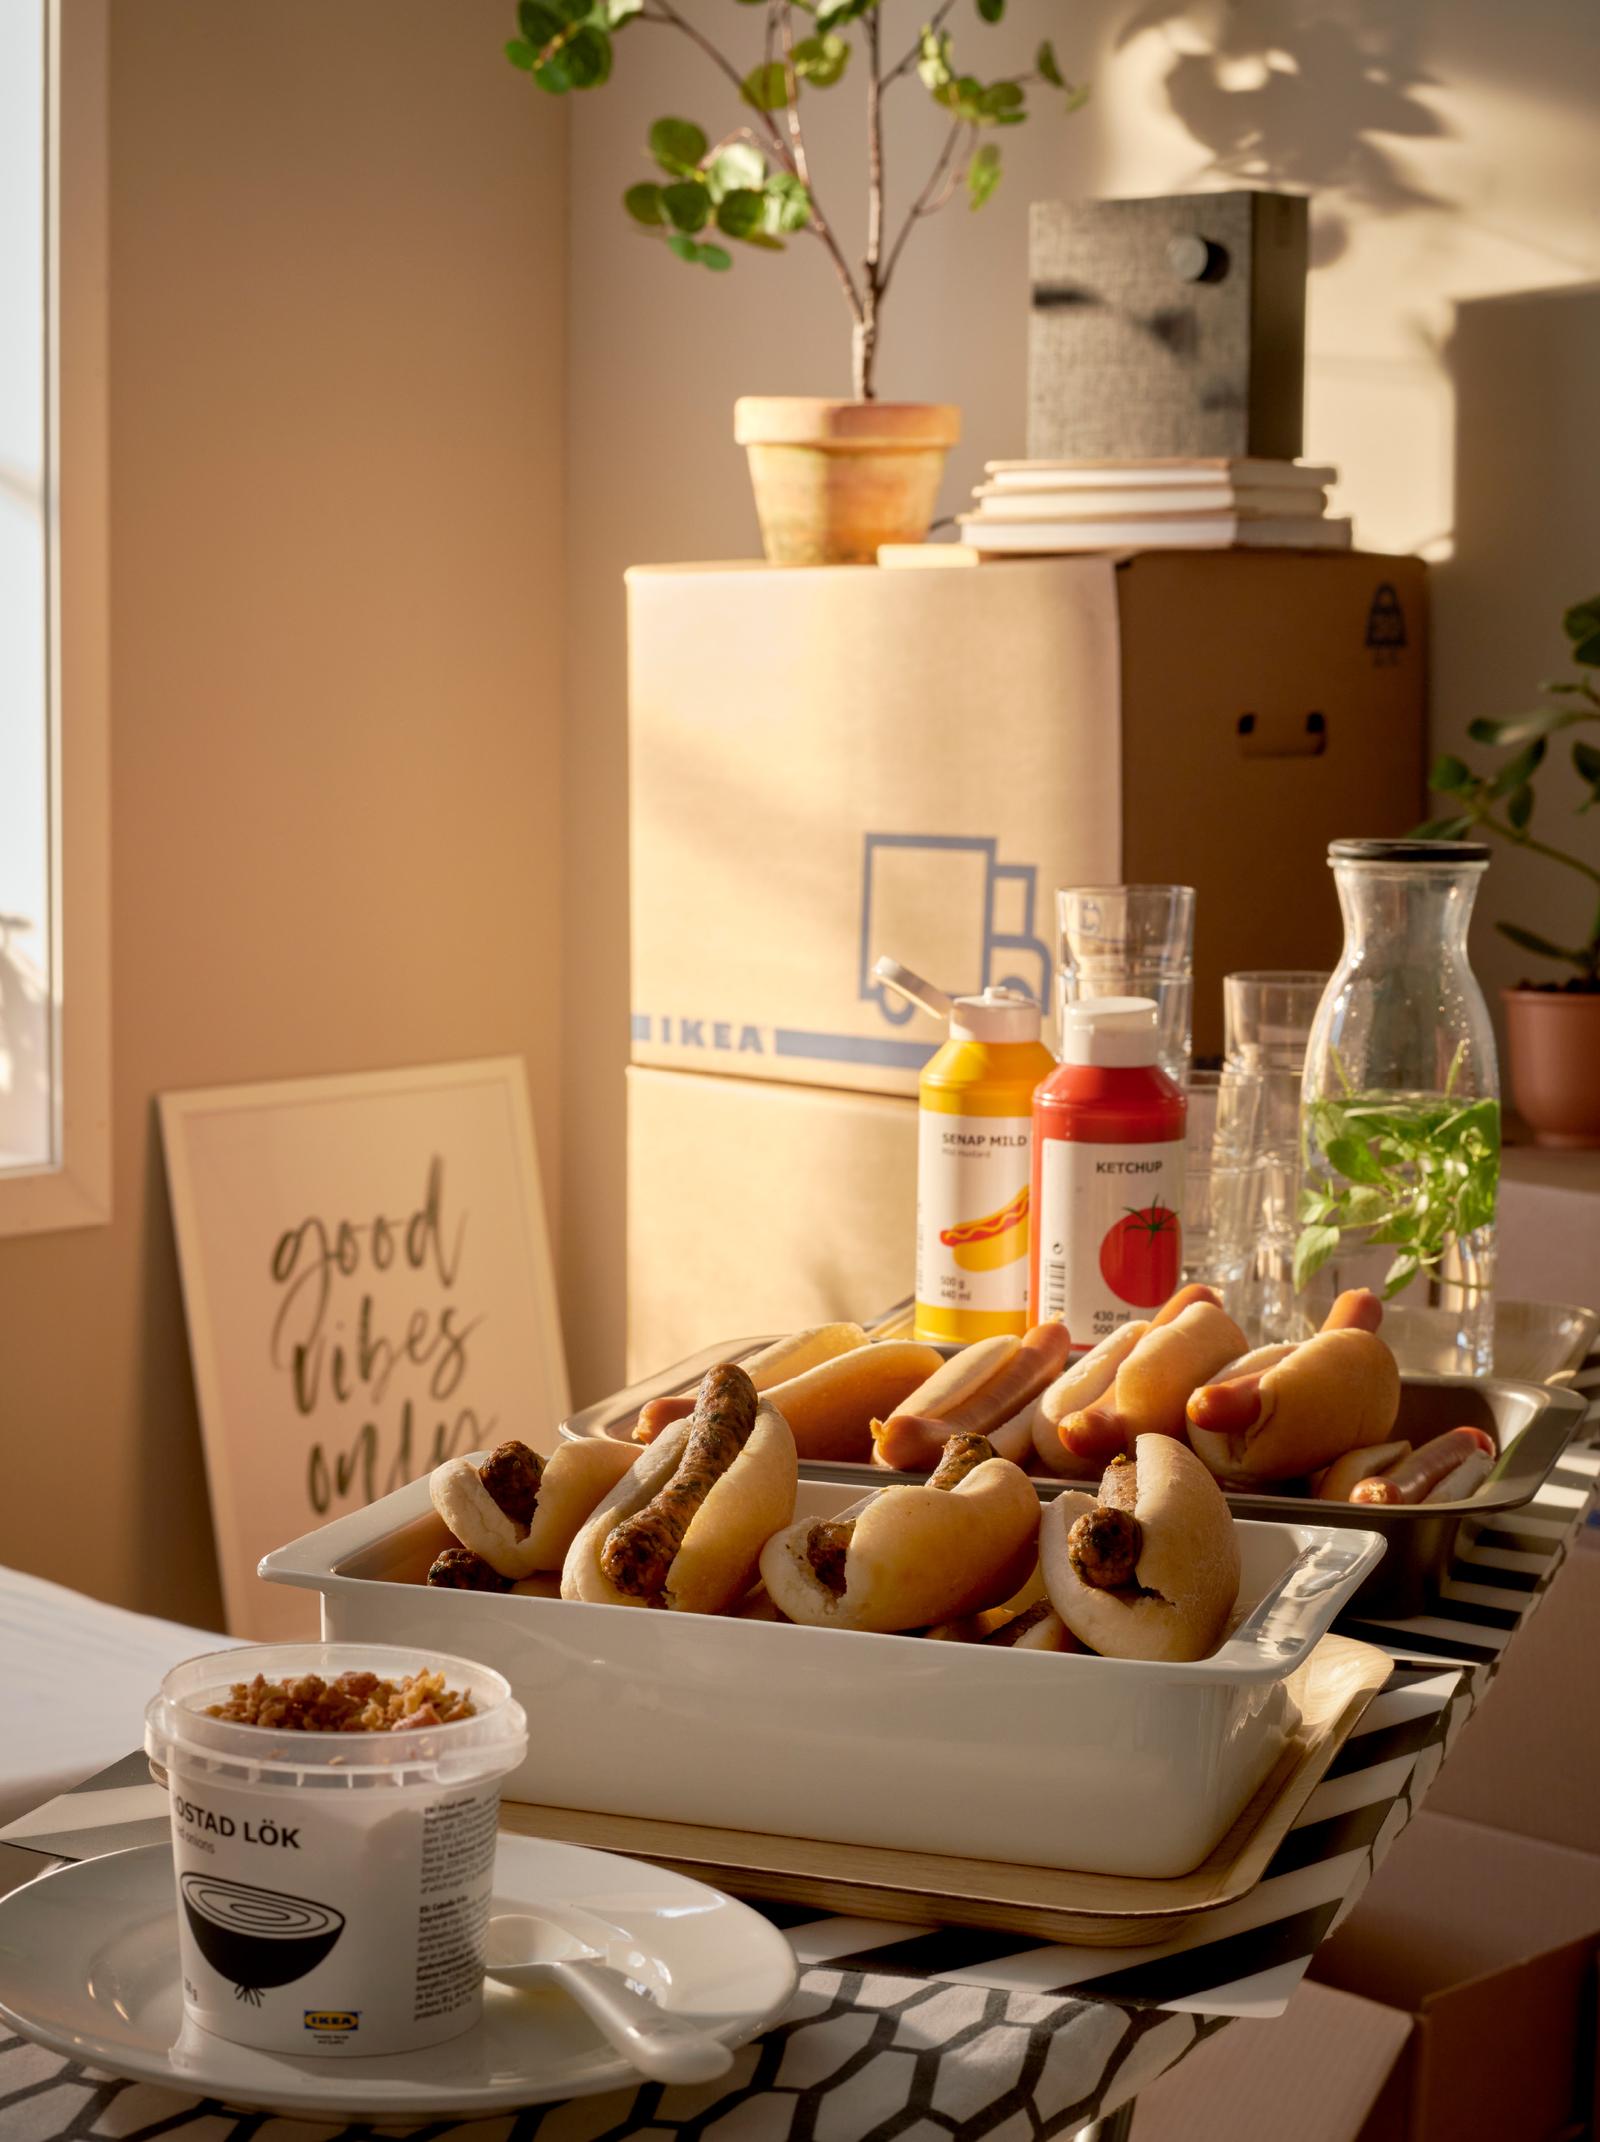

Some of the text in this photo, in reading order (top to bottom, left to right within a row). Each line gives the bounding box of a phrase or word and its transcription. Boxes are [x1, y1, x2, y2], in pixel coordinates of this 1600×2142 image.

[661, 1015, 764, 1055] IKEA
[943, 1133, 1028, 1147] SENAP MILD
[1096, 1160, 1163, 1174] KETCHUP
[270, 1152, 468, 1370] good
[1093, 1311, 1130, 1322] 430 ml
[1093, 1323, 1114, 1335] 500
[292, 1294, 486, 1415] vibes
[176, 1795, 236, 1838] OSTAD
[243, 1818, 301, 1851] LÖK
[311, 2015, 352, 2025] IKEA
